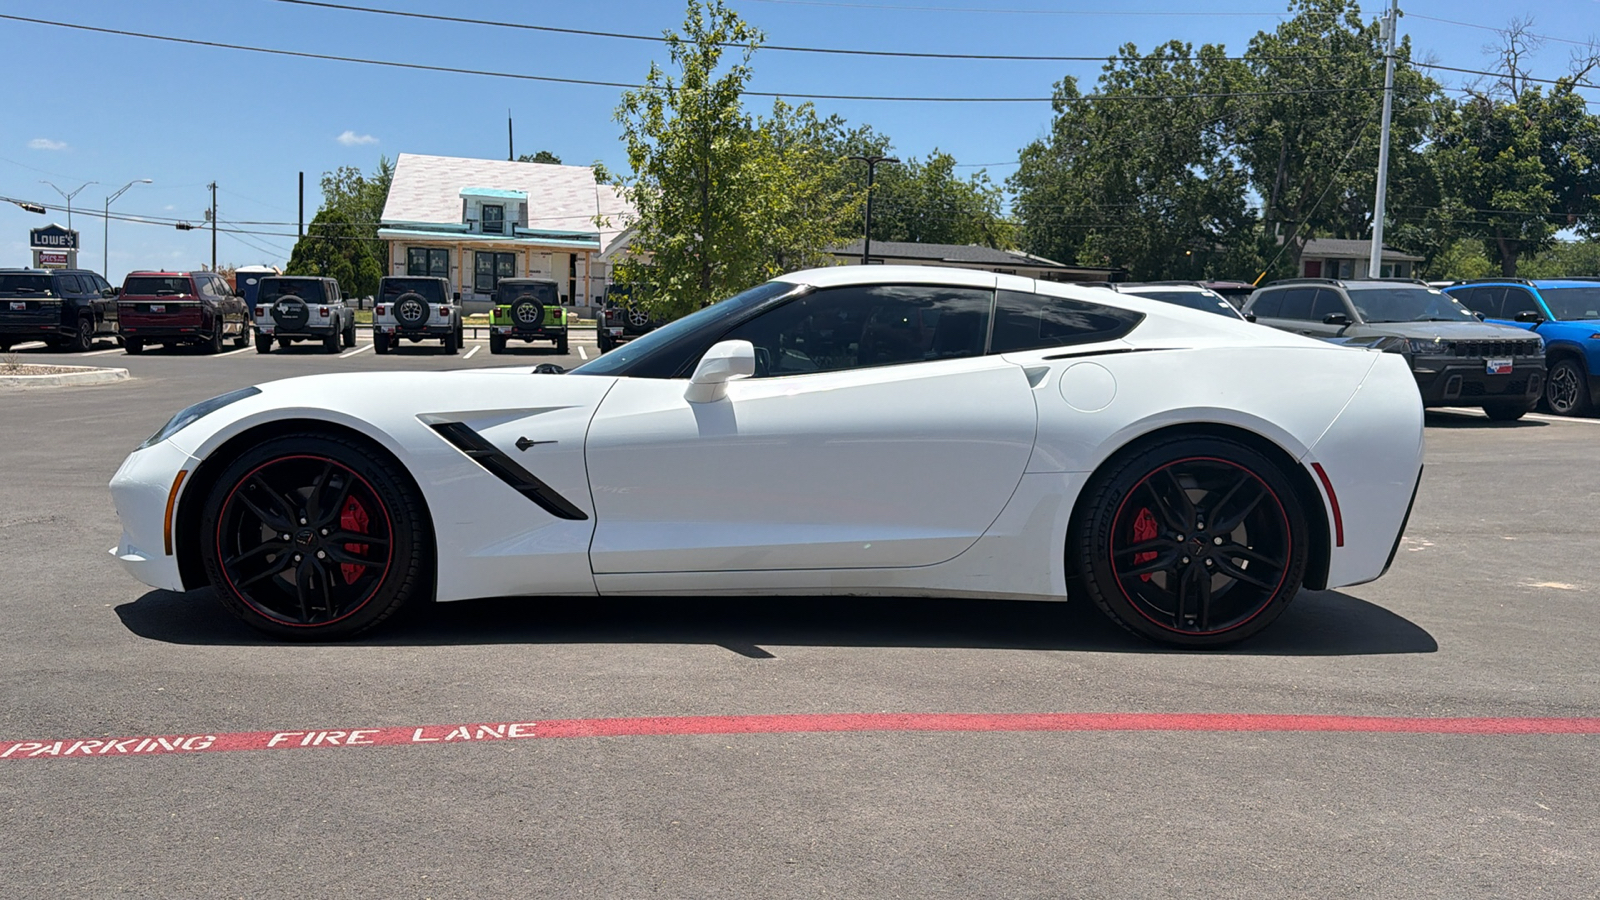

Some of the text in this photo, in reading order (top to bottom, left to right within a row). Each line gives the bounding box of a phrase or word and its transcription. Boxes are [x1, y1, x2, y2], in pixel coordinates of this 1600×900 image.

[34, 233, 74, 246] LOWE'S
[0, 723, 536, 757] PARKING FIRE LANE
